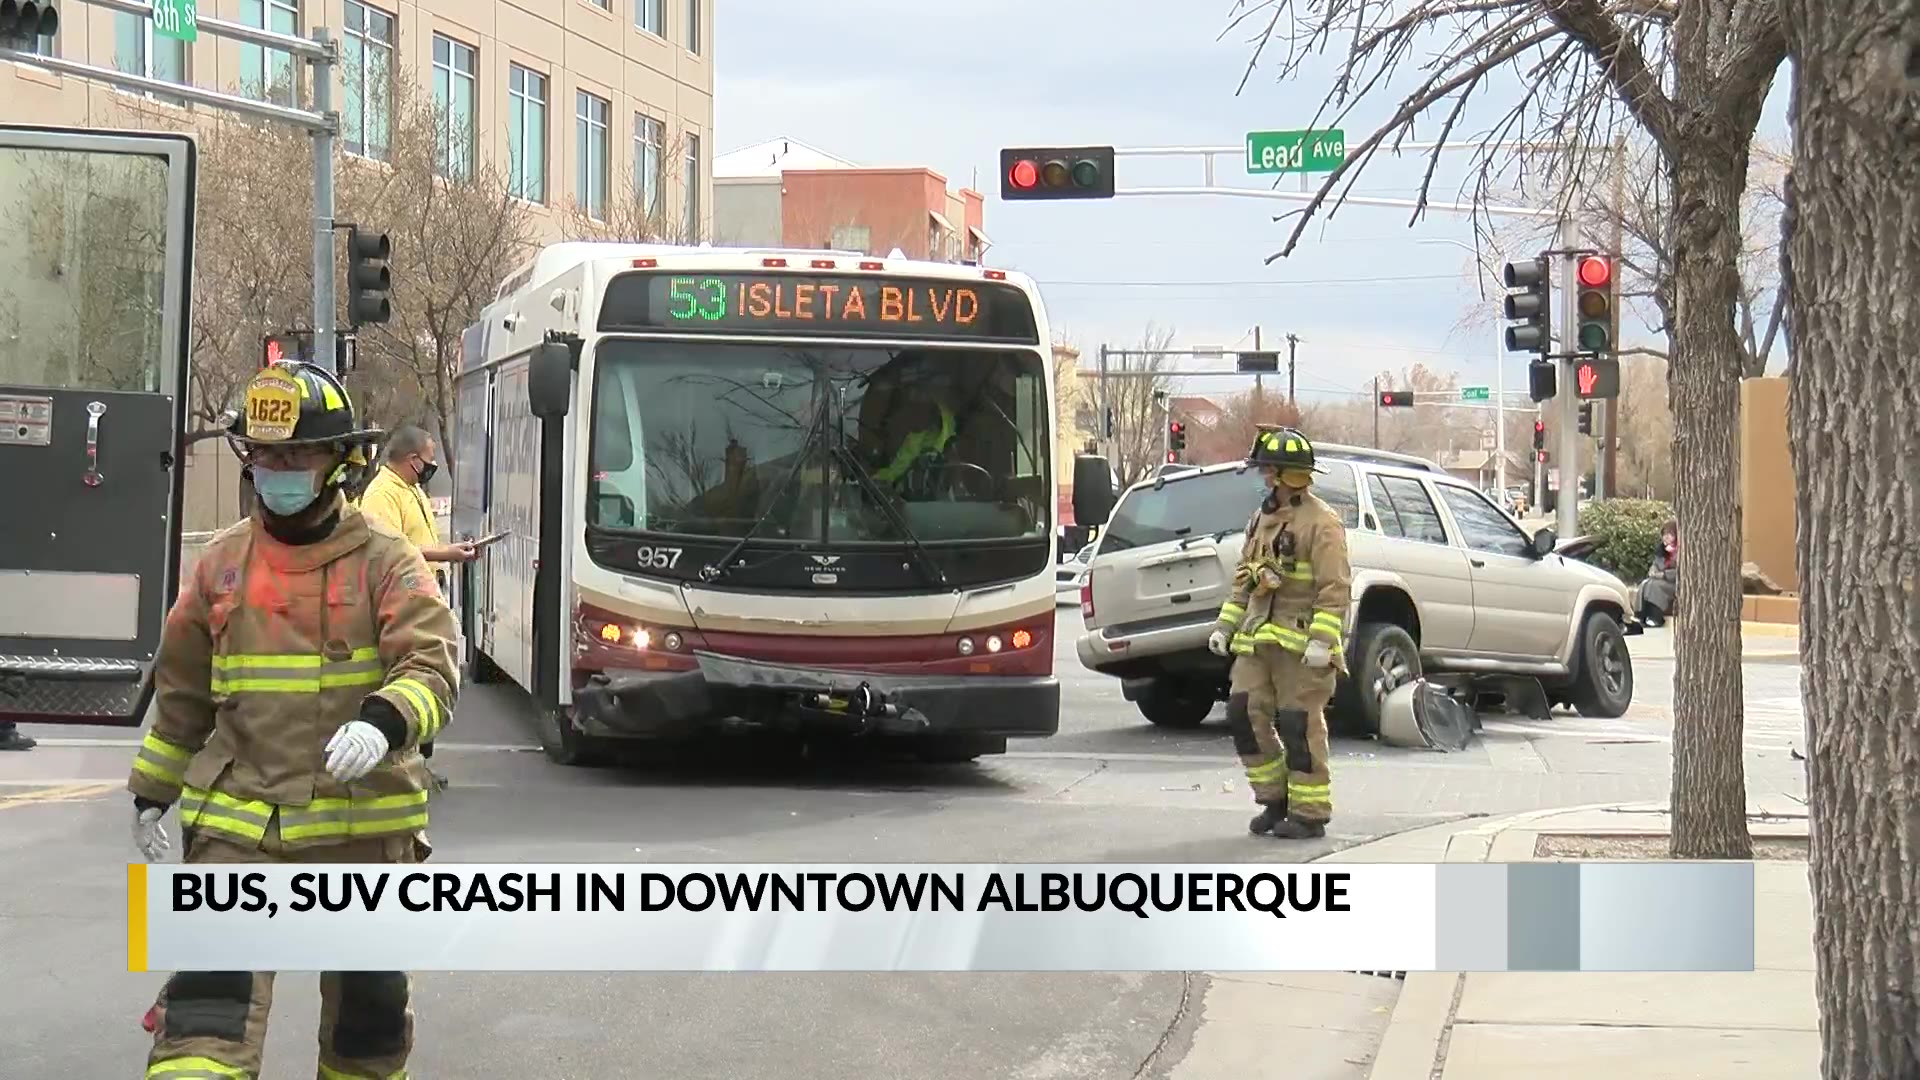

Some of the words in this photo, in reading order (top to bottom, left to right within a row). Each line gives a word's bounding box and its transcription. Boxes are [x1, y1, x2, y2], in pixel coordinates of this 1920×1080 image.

[153, 0, 180, 33] 6th
[184, 3, 196, 27] St
[1248, 138, 1303, 169] Lead
[1313, 138, 1343, 158] Ave
[670, 277, 726, 321] 53
[738, 282, 867, 321] ISLETA
[881, 286, 979, 324] BLVD
[250, 397, 292, 423] 1622
[637, 546, 683, 569] 957
